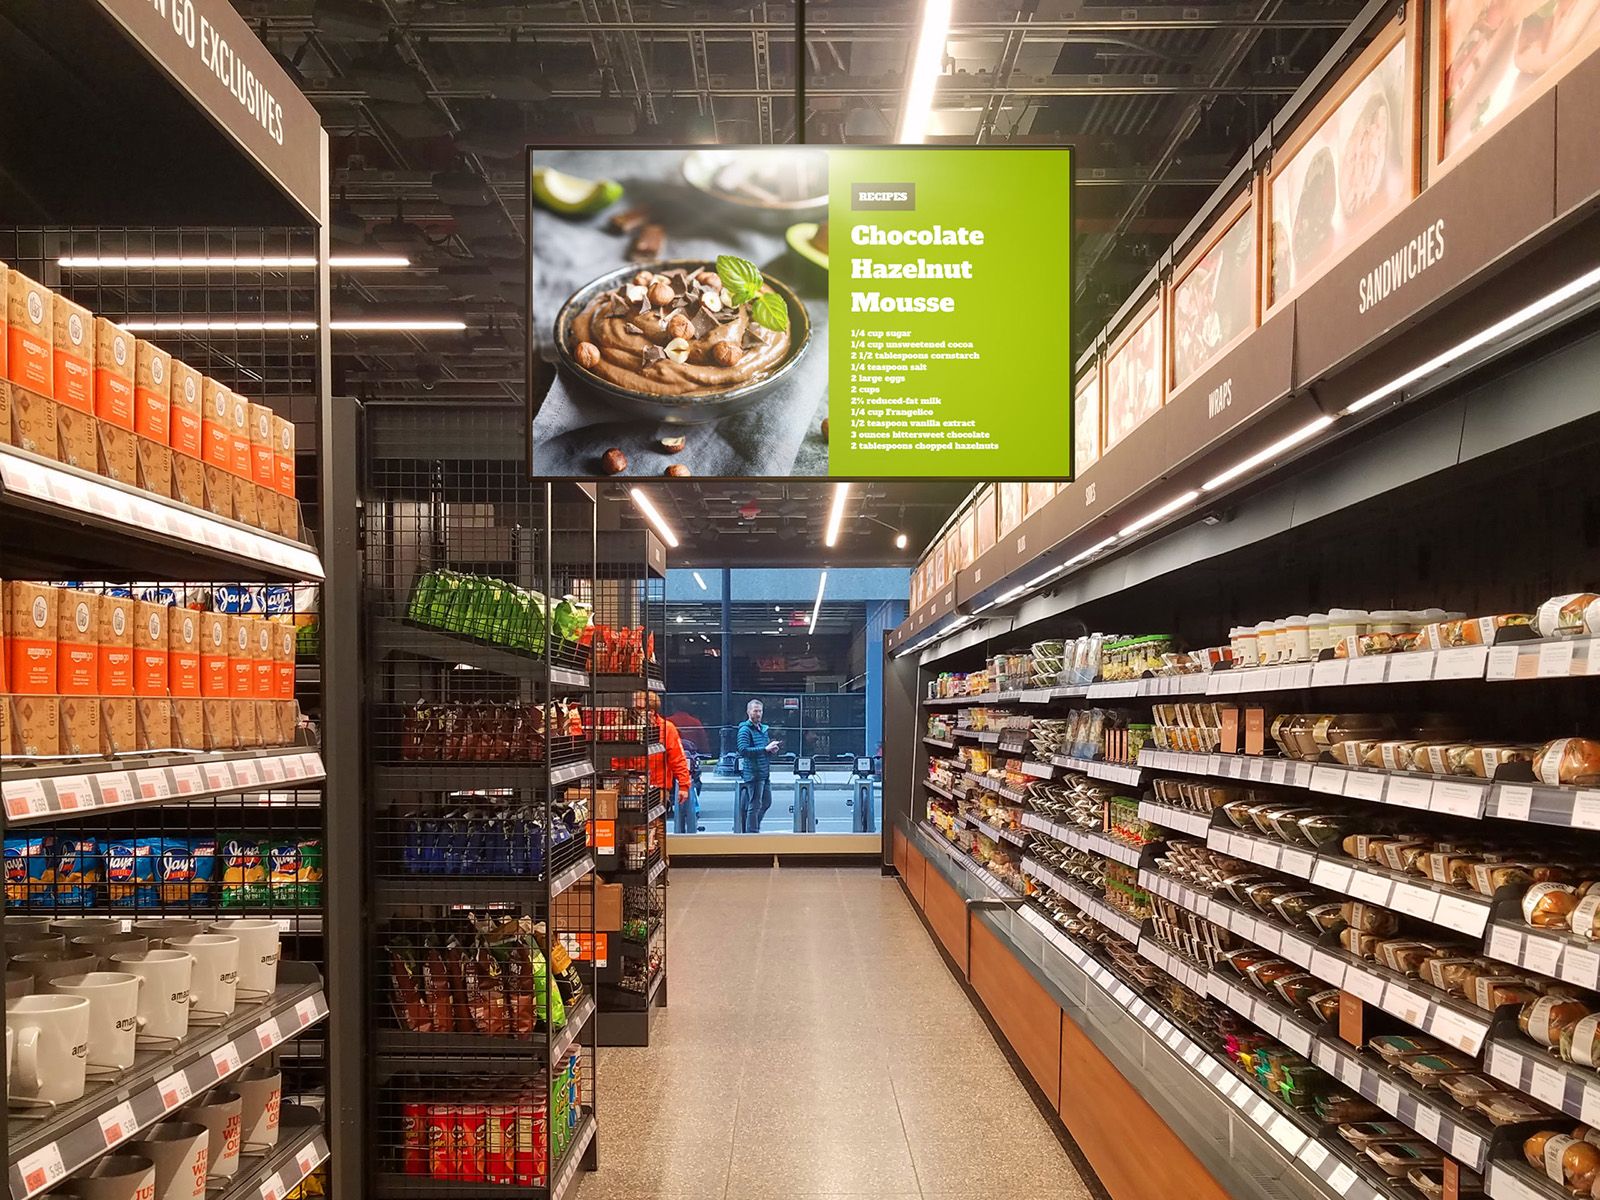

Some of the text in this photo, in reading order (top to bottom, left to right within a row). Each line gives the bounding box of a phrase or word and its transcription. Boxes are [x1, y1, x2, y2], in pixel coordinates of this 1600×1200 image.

[200, 15, 284, 146] EXCLUSIVES
[858, 192, 908, 201] RECIPES
[850, 225, 985, 245] Chocolate
[850, 258, 973, 279] Hazelnut
[1359, 218, 1444, 314] SANDWICHES
[850, 292, 955, 312] Mousse
[851, 329, 866, 338] 1/4
[885, 331, 912, 339] sugar
[851, 340, 866, 349] 1/4
[867, 342, 884, 350] cup
[859, 352, 873, 360] 1/2
[875, 352, 929, 361] tablespoons
[850, 363, 928, 372] 1/4 teaspoon salt
[850, 374, 906, 384] 2 large eggs
[858, 387, 881, 395] cups
[850, 397, 865, 405] 2%
[919, 397, 942, 405] milk
[1208, 378, 1233, 419] WRAPS
[850, 408, 866, 416] 1/4
[885, 408, 934, 417] Frangelico
[850, 419, 865, 428] 1/2
[866, 420, 908, 428] teaspoon
[858, 442, 914, 451] tablespoons
[914, 442, 954, 451] chopped
[954, 442, 1000, 450] hazelnuts
